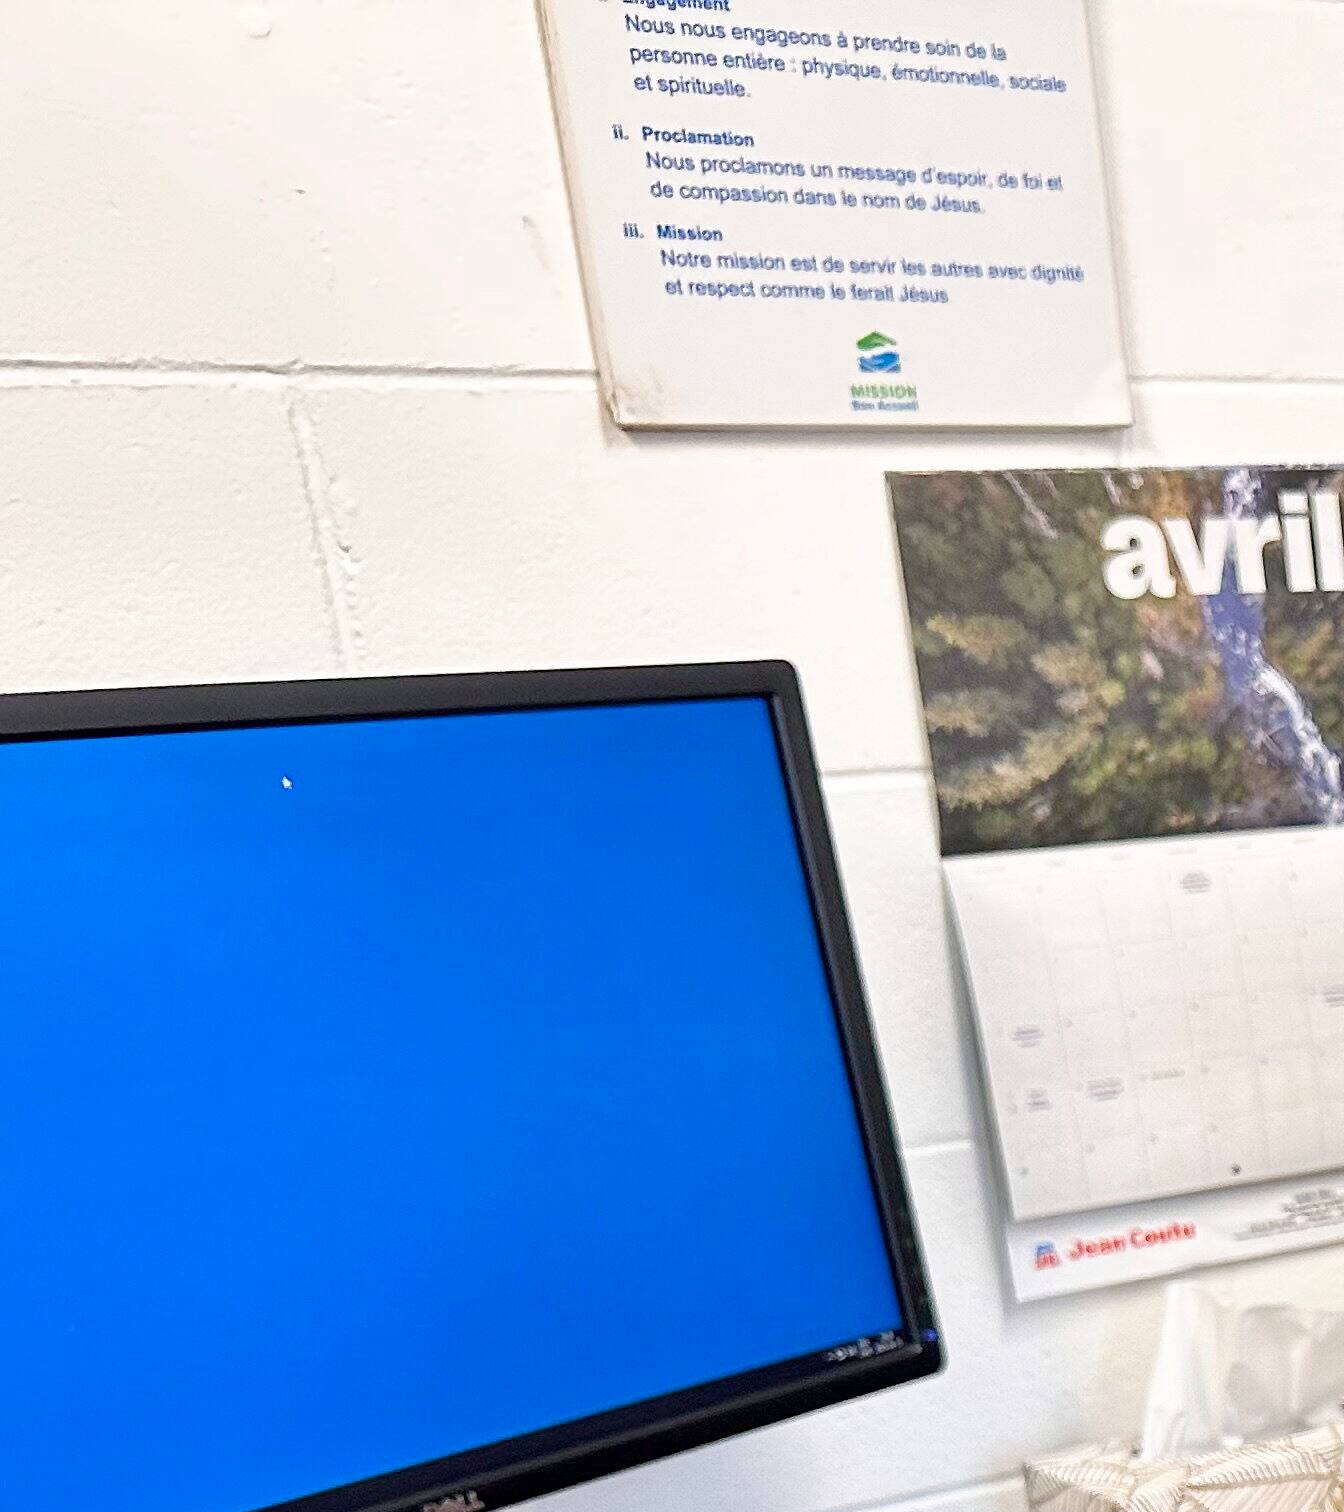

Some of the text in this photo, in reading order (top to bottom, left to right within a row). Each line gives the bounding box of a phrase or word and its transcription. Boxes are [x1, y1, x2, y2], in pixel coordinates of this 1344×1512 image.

[624, 14, 1007, 61] Nous nous engageons à prendre soin de la
[629, 46, 718, 67] personne
[723, 51, 786, 72] entière
[802, 56, 887, 81] physique,
[892, 61, 1005, 90] émotionnelle,
[1009, 73, 1067, 93] sociale
[634, 75, 752, 98] et spirituelle.
[641, 125, 756, 147] Proclamation
[645, 151, 696, 171] Nous
[700, 156, 806, 178] proclamons
[810, 162, 833, 179] un
[838, 165, 917, 186] message
[997, 171, 1019, 190] de
[1022, 172, 1043, 191] foi
[1047, 174, 1064, 192] et
[650, 180, 674, 199] de
[679, 184, 789, 205] compassion
[793, 186, 837, 207] dans
[841, 189, 858, 208] le
[862, 192, 901, 210] nom
[905, 193, 927, 212] de
[656, 223, 724, 242] Mission
[660, 249, 1085, 285] Notre mission est de servir les autres avec dignité
[665, 279, 683, 296] et
[688, 279, 756, 300] respect
[760, 282, 826, 301] comme
[831, 282, 847, 301] le
[899, 284, 950, 304] Jésus
